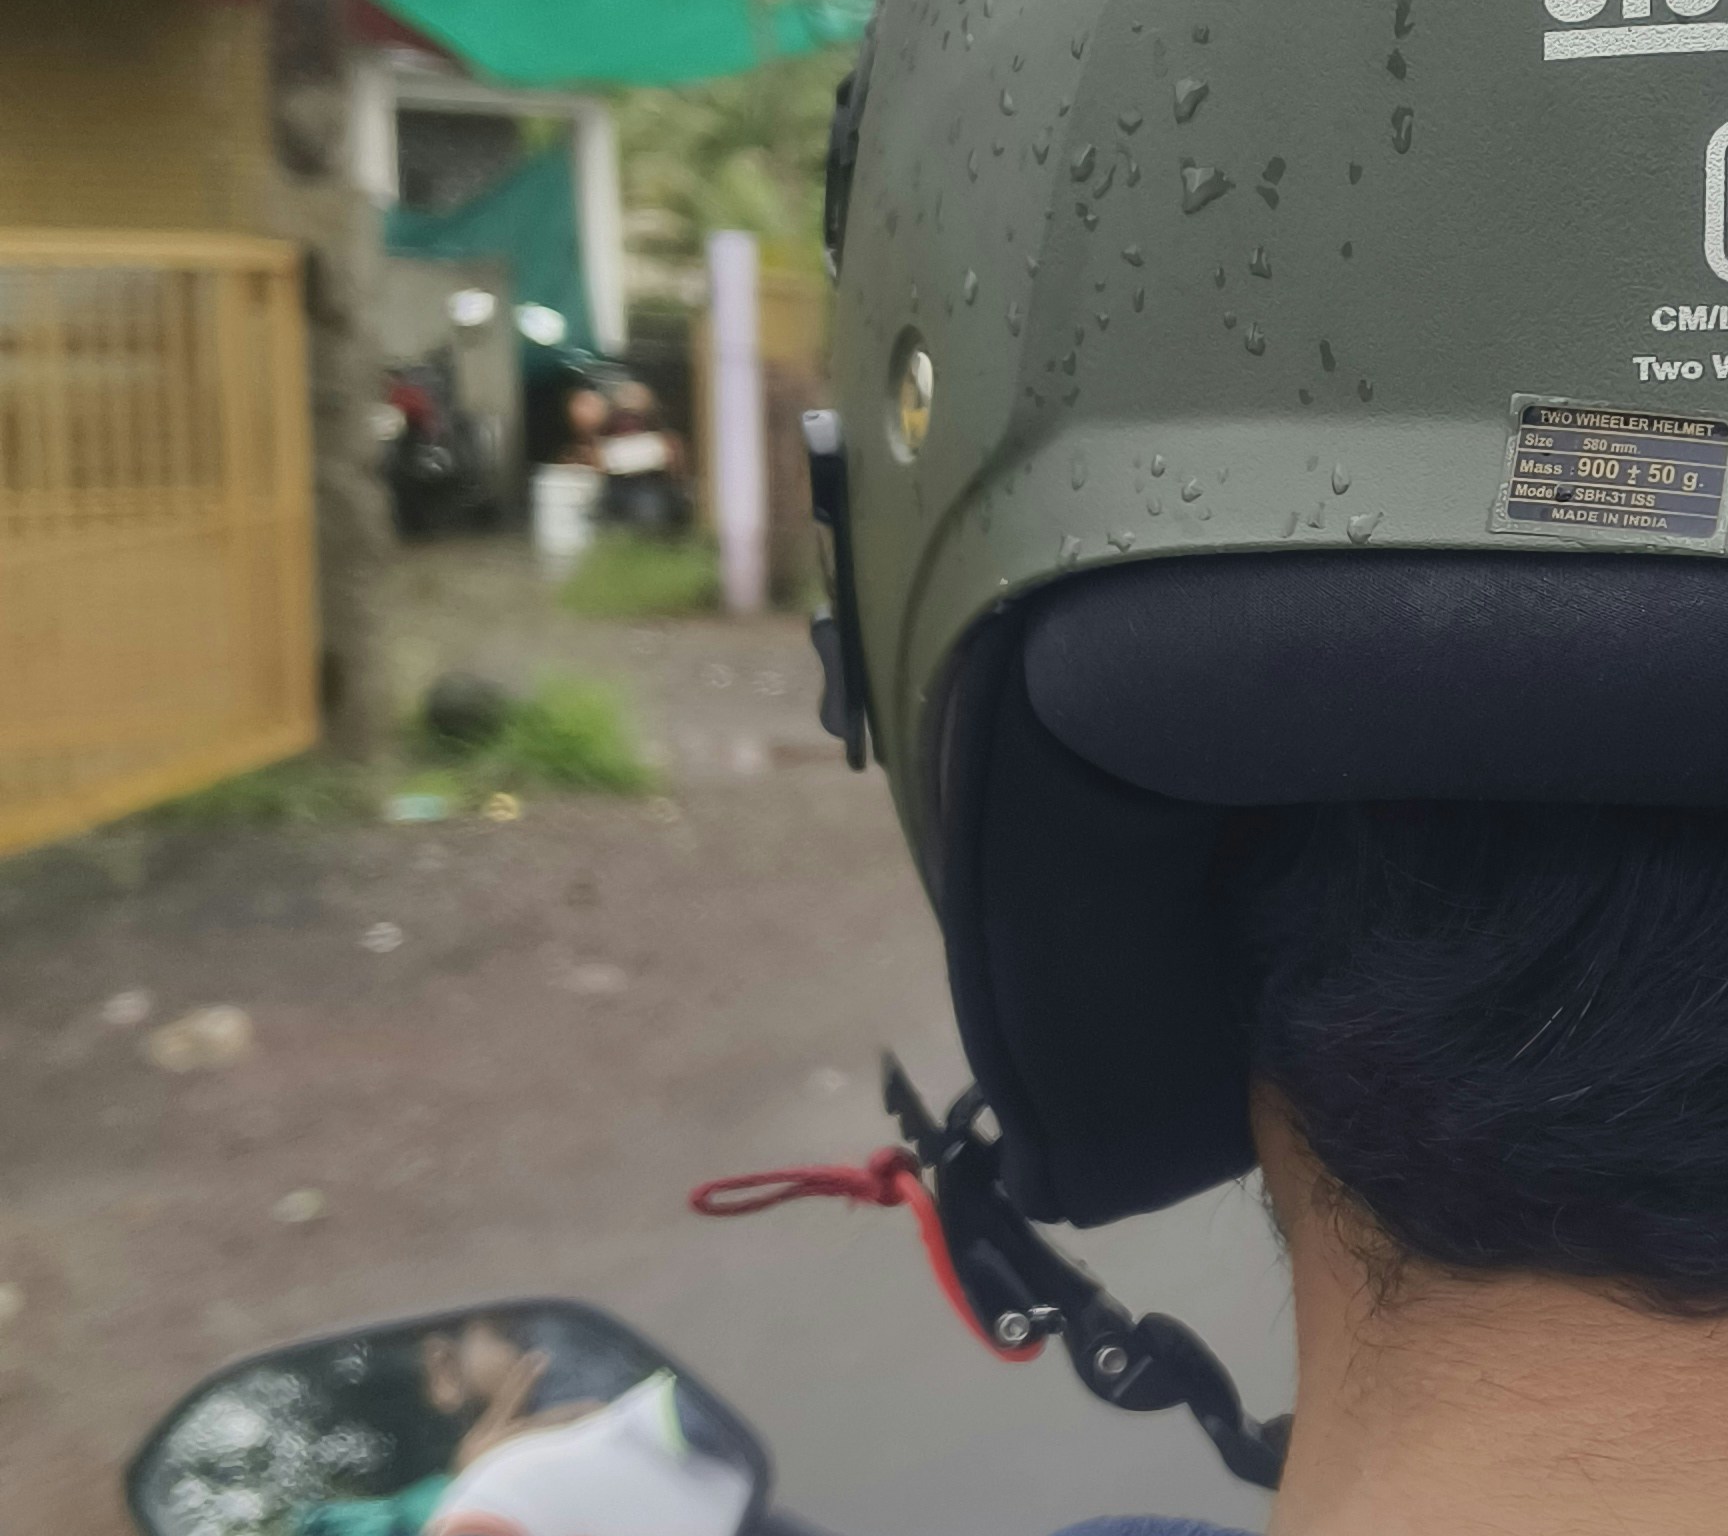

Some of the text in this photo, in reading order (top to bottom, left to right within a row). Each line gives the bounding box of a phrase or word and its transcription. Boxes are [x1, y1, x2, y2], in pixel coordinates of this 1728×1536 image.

[1633, 355, 1703, 382] Two
[1540, 410, 1715, 437] TWO WHEELER HELMET
[1524, 433, 1554, 448] Size
[1583, 437, 1608, 451] 580
[1519, 459, 1563, 476] Mass
[1577, 457, 1620, 479] 900
[1647, 463, 1676, 485] 50
[1574, 488, 1627, 505] SBH-31
[1551, 507, 1668, 529] MADE IN INDIA
